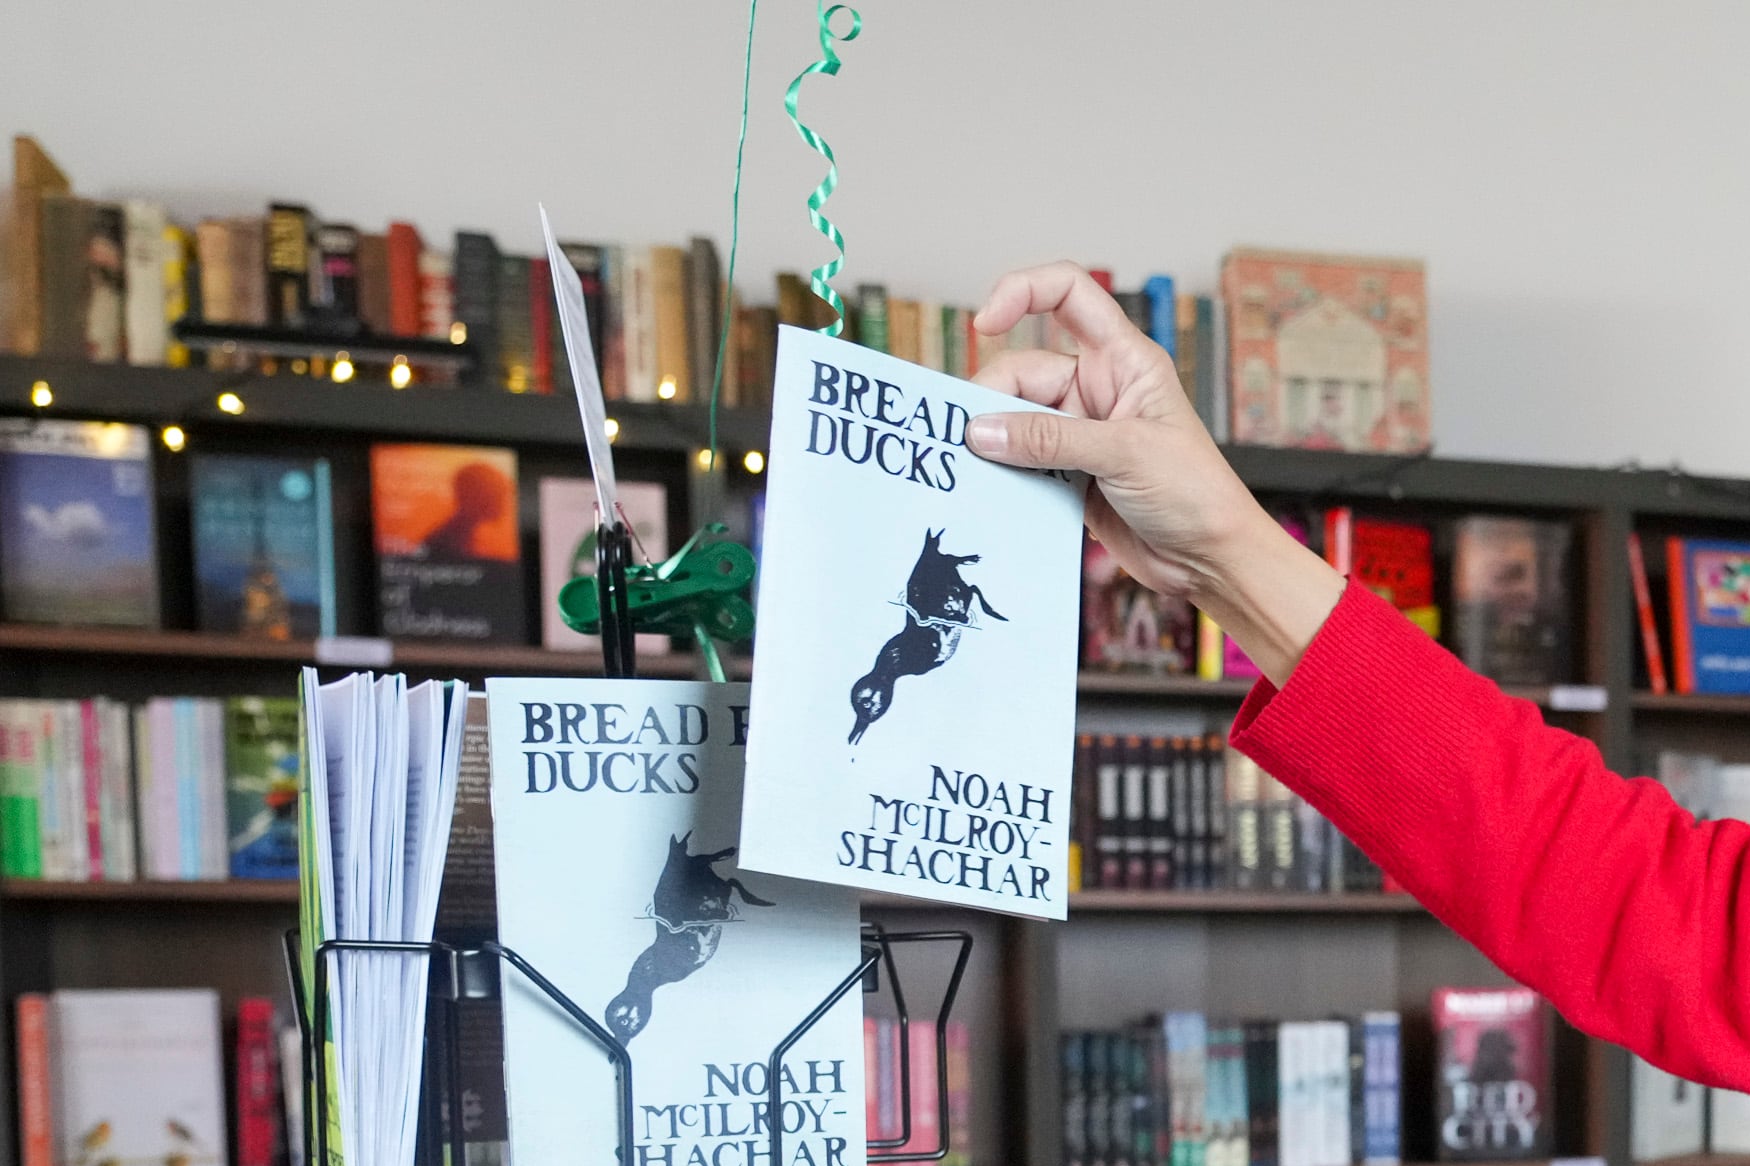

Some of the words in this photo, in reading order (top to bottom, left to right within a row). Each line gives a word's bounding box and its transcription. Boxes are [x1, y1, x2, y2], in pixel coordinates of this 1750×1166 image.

[808, 359, 970, 447] BREAD
[805, 408, 956, 492] DUCKS
[519, 701, 709, 746] BREAD
[522, 751, 700, 794] DUCKS
[927, 764, 1054, 824] NOAH
[836, 831, 1052, 902] SHACHAR
[702, 1059, 847, 1098] NOAH
